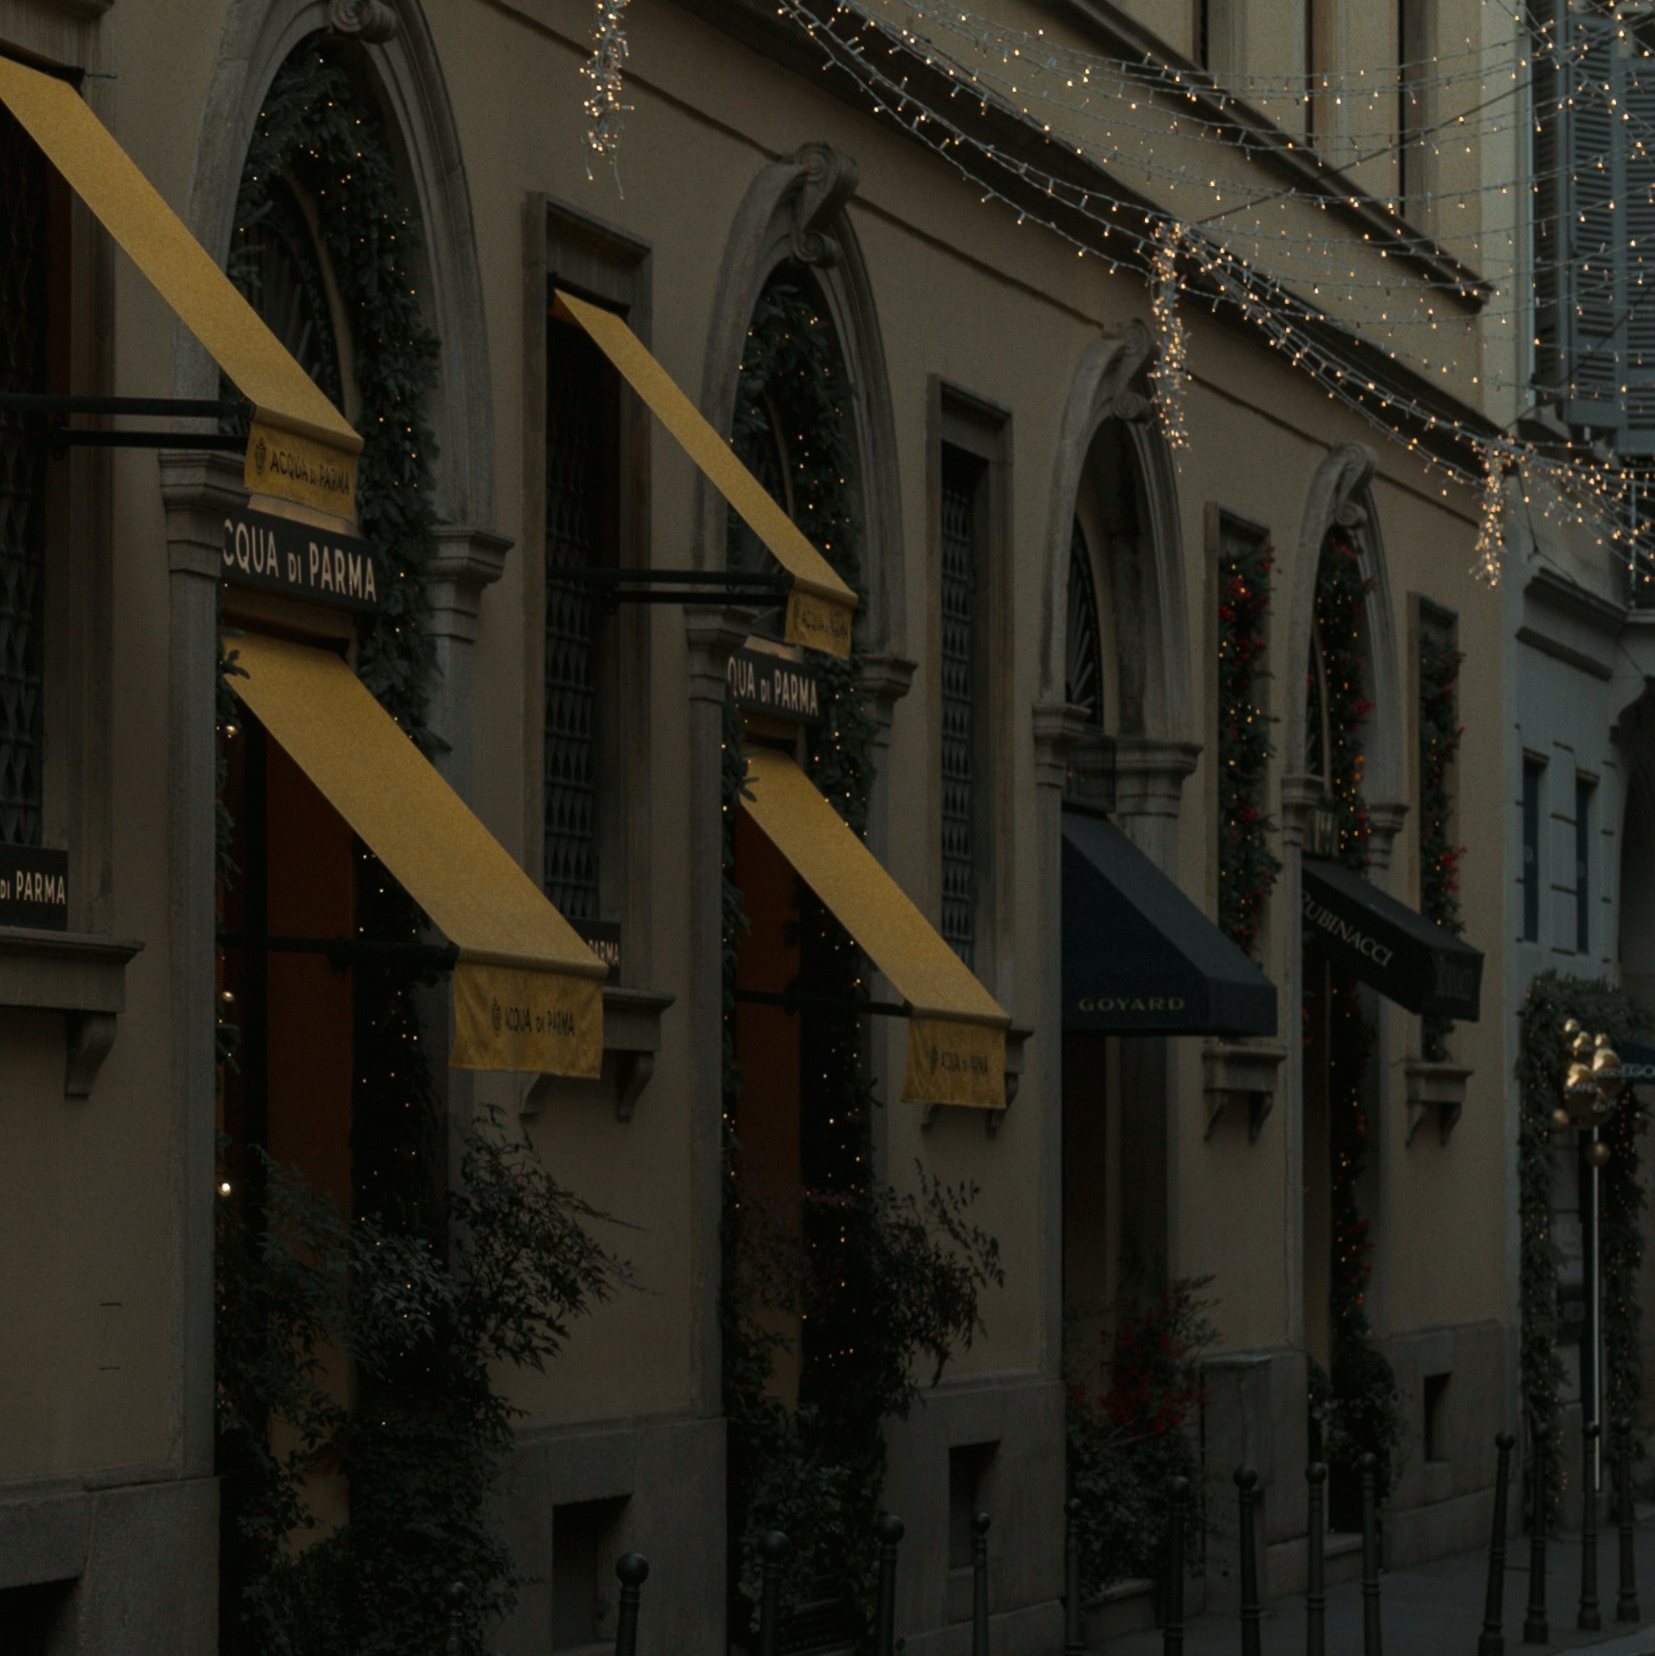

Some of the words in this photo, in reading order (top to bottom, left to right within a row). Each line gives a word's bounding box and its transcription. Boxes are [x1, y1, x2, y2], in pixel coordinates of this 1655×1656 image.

[270, 449, 309, 483] ACQUA
[222, 518, 279, 578] CQUA
[287, 552, 303, 585] DI
[309, 541, 378, 603] PARMA
[774, 668, 819, 717] PARMA
[15, 869, 66, 905] PARMA
[1078, 997, 1185, 1012] GOYARD
